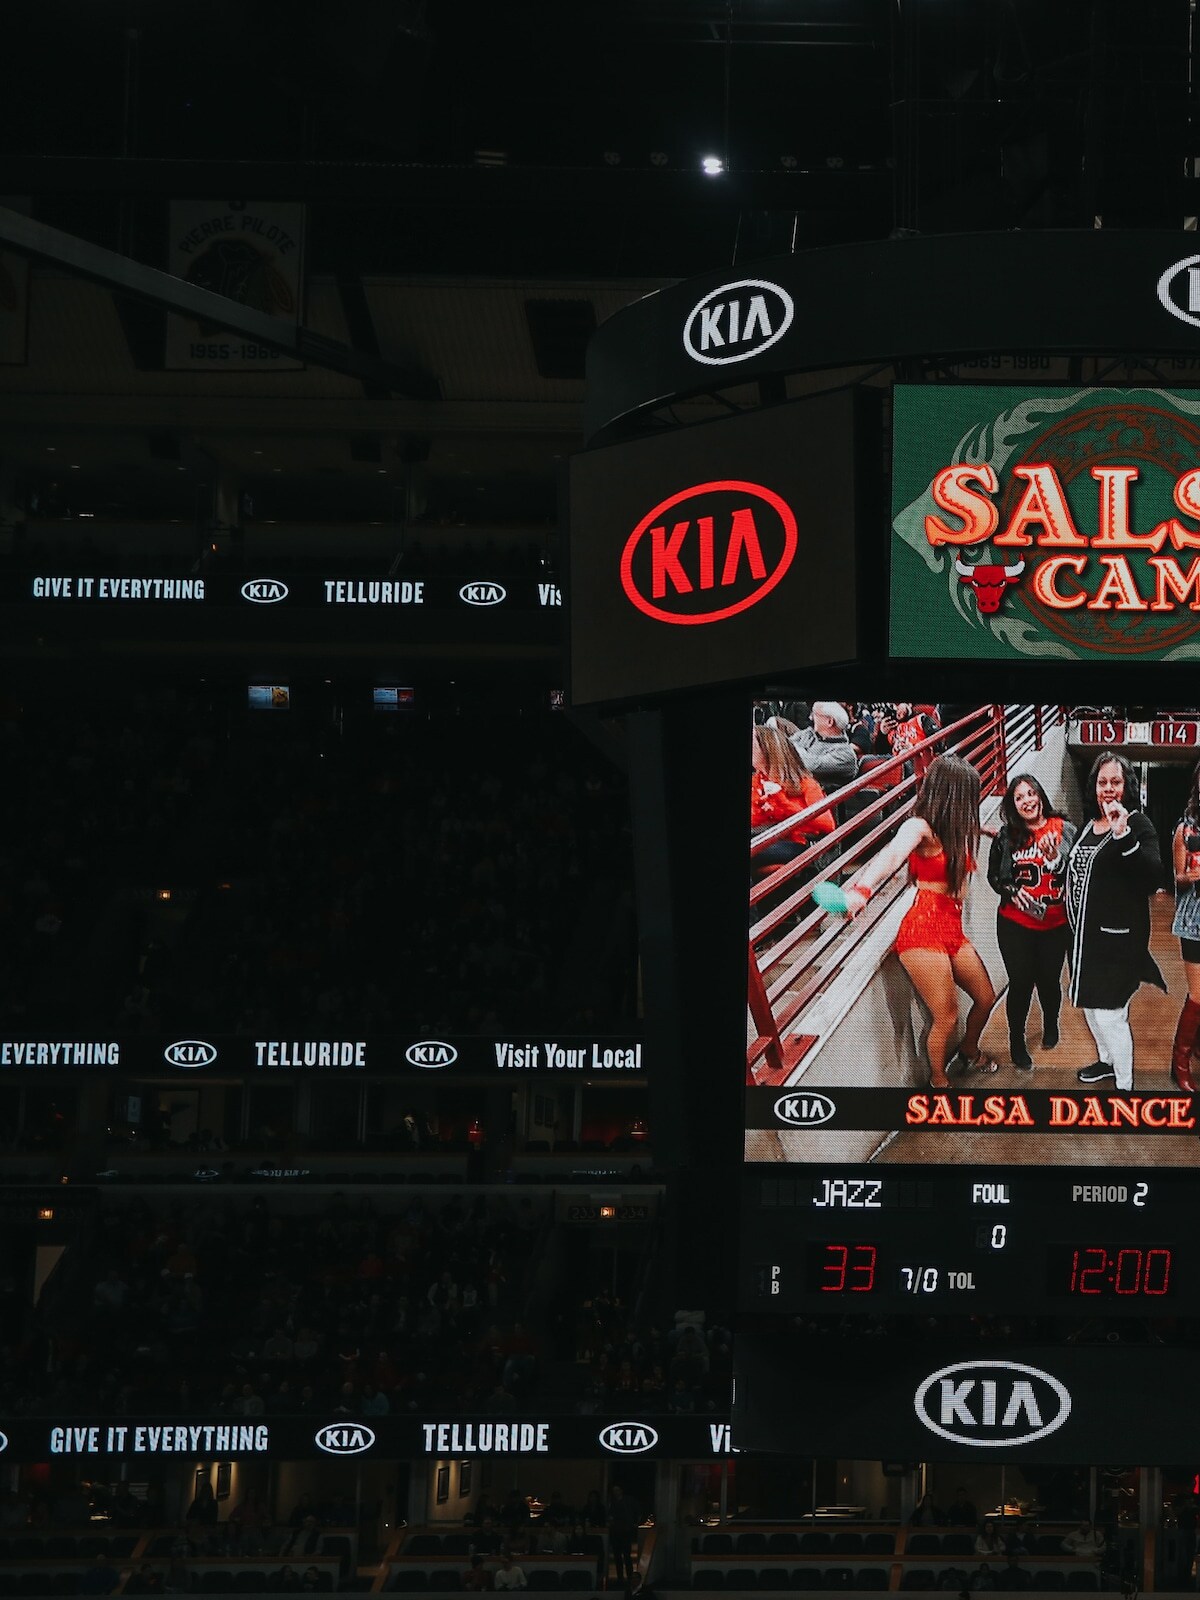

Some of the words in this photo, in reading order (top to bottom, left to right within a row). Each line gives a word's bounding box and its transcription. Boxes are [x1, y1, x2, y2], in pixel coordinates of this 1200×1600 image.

[179, 215, 236, 254] PIERRE
[241, 214, 297, 255] PILOTE
[701, 296, 772, 350] KIA
[650, 509, 766, 598] KIA
[33, 577, 72, 598] GIVE
[77, 577, 95, 598] IT
[99, 578, 205, 600] EVERYTHING
[248, 584, 280, 598] KIA
[324, 580, 425, 604] TELLURIDE
[467, 587, 499, 601] KIA
[538, 583, 562, 606] Vis
[1088, 723, 1116, 743] 113
[1160, 723, 1187, 743] 114
[1, 1042, 120, 1065] EVERYTHING
[174, 1047, 208, 1061] KIA
[255, 1041, 367, 1067] TELLURIDE
[414, 1047, 448, 1061] KIA
[494, 1042, 539, 1068] Visit
[545, 1043, 587, 1068] Your
[591, 1043, 642, 1069] Local
[785, 1100, 824, 1117] KIA
[906, 1094, 1034, 1126] SALSA
[1048, 1096, 1196, 1129] DANCE
[812, 1180, 882, 1208] JAZZ
[972, 1183, 1010, 1204] FOUL
[1072, 1185, 1128, 1203] PERIOD
[1132, 1182, 1149, 1207] 2
[990, 1224, 1007, 1249] 0
[822, 1245, 877, 1292] 33
[901, 1266, 939, 1294] 7/0
[947, 1272, 976, 1290] TOL
[1071, 1249, 1171, 1296] 12:00
[940, 1380, 1043, 1425] KIA
[50, 1427, 100, 1453] GIVE
[107, 1426, 128, 1452] IT
[134, 1425, 269, 1452] EVERYTHING
[326, 1430, 365, 1447] KIA
[422, 1423, 550, 1452] TELLURIDE
[609, 1429, 648, 1446] KIA
